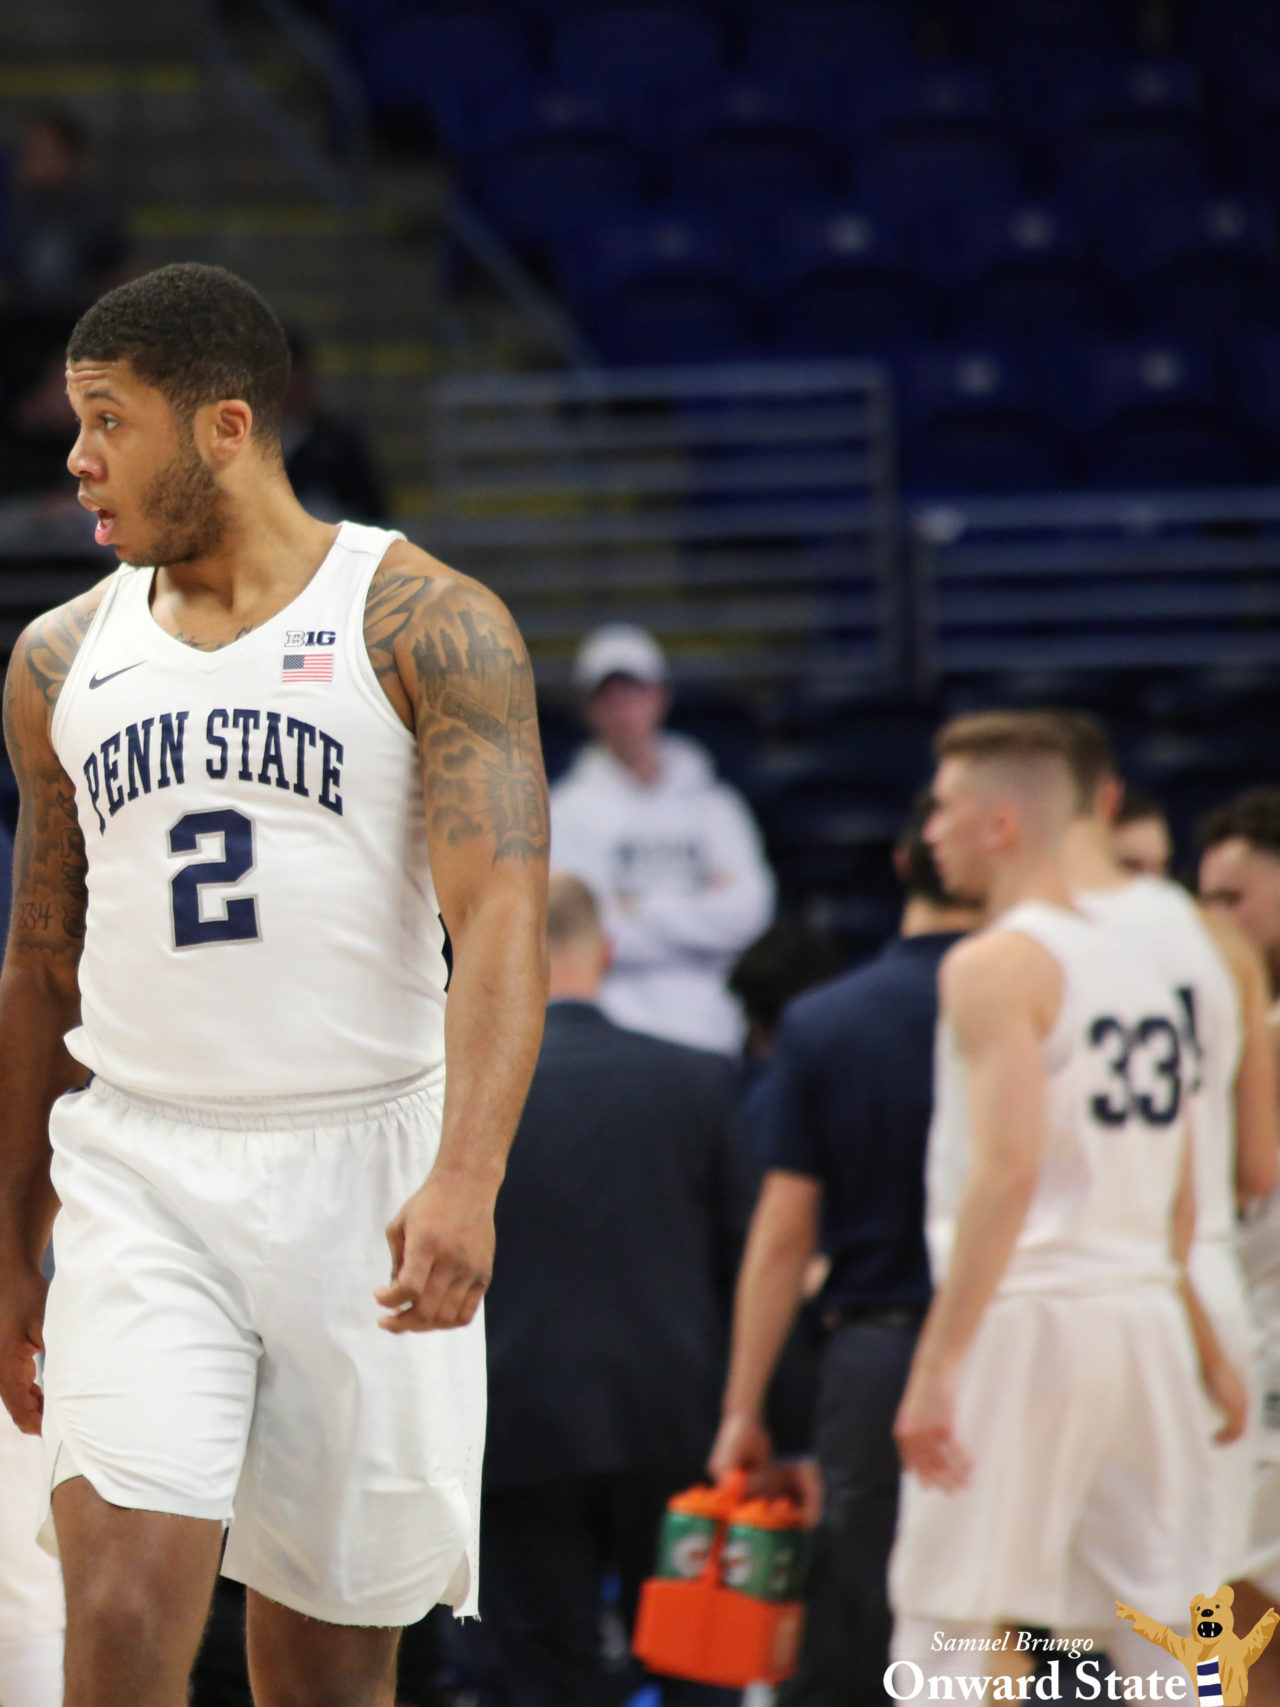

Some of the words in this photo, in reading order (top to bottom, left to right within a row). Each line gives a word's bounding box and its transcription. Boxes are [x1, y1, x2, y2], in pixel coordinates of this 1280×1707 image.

[83, 710, 189, 837] PENN
[205, 708, 344, 816] STATE
[166, 805, 263, 952] 2
[1089, 1014, 1182, 1127] 33
